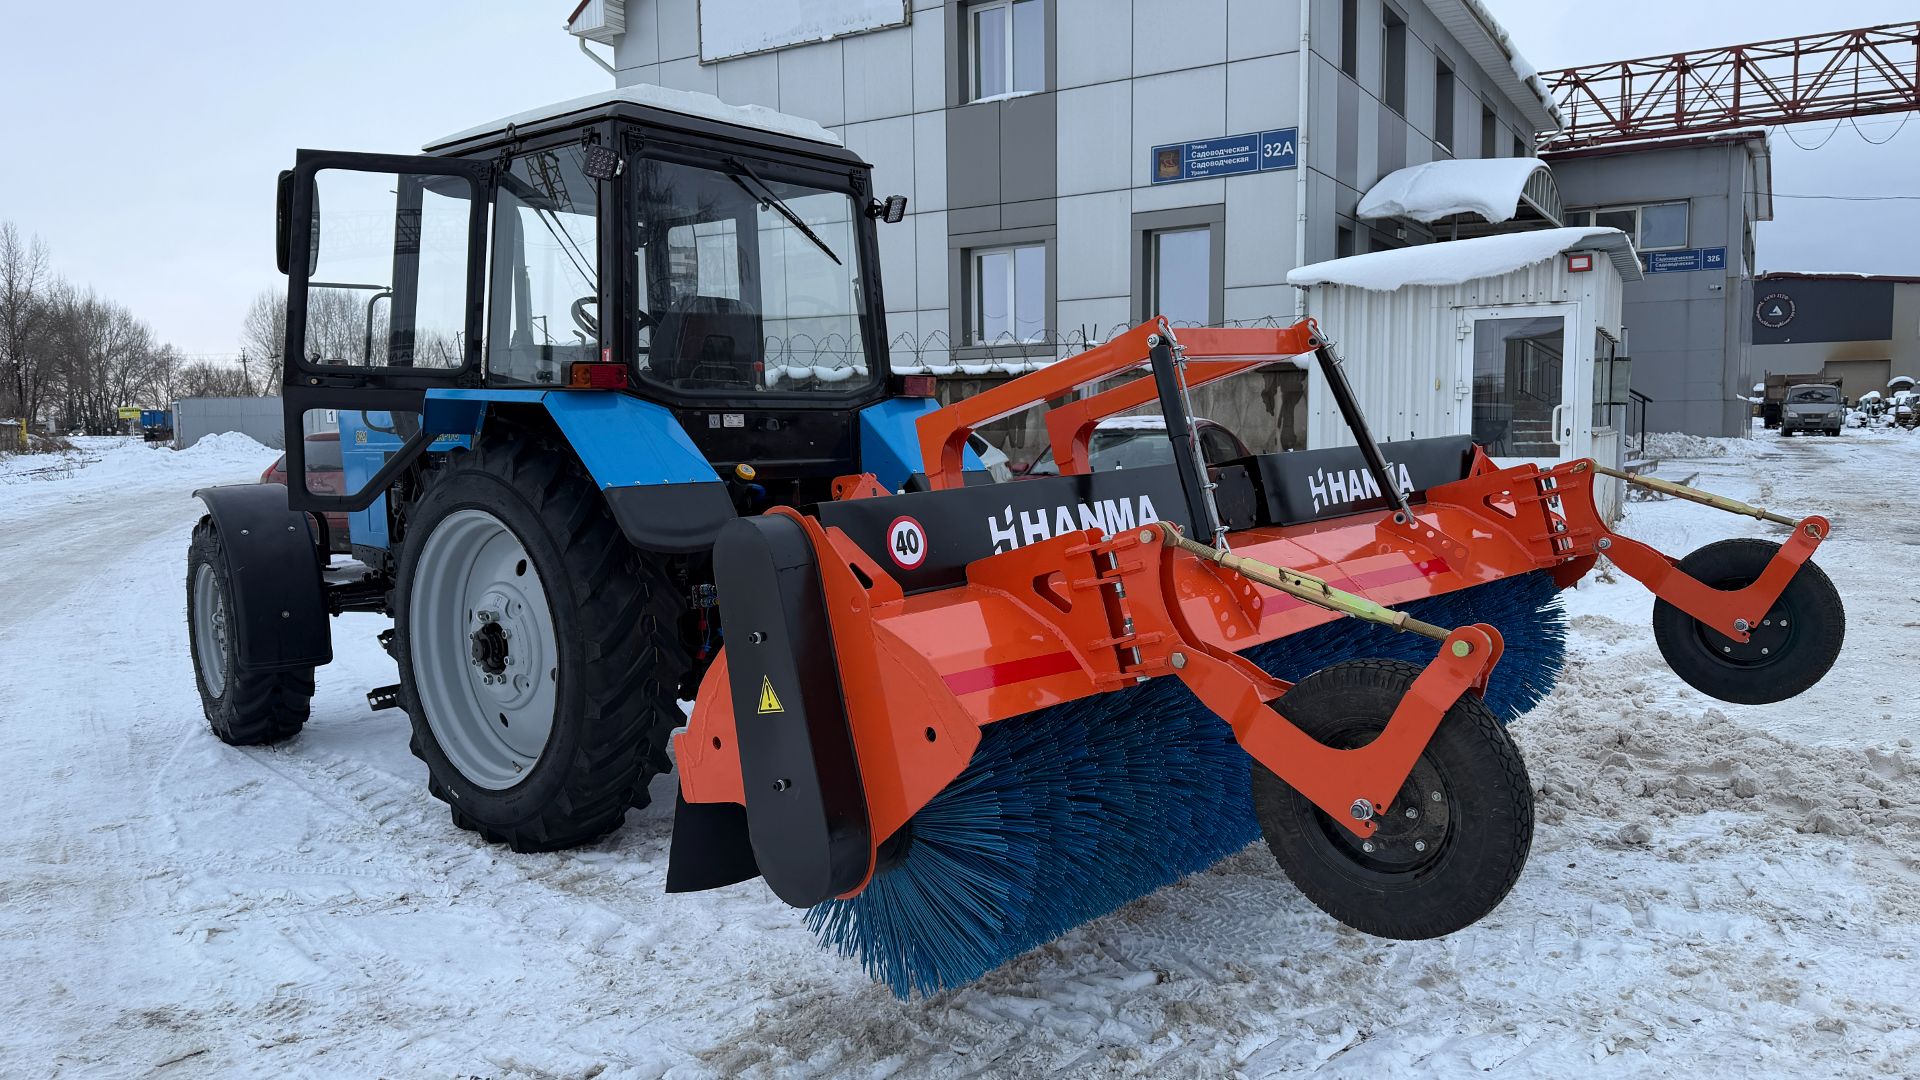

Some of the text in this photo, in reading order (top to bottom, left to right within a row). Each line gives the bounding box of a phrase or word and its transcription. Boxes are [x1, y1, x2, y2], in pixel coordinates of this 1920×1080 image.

[1191, 145, 1249, 158] Садоводческая
[1264, 141, 1294, 158] 32А
[1191, 156, 1249, 169] Садоводческая
[1327, 463, 1415, 504] HANA
[1020, 494, 1160, 546] HANMA
[896, 528, 919, 556] 40
